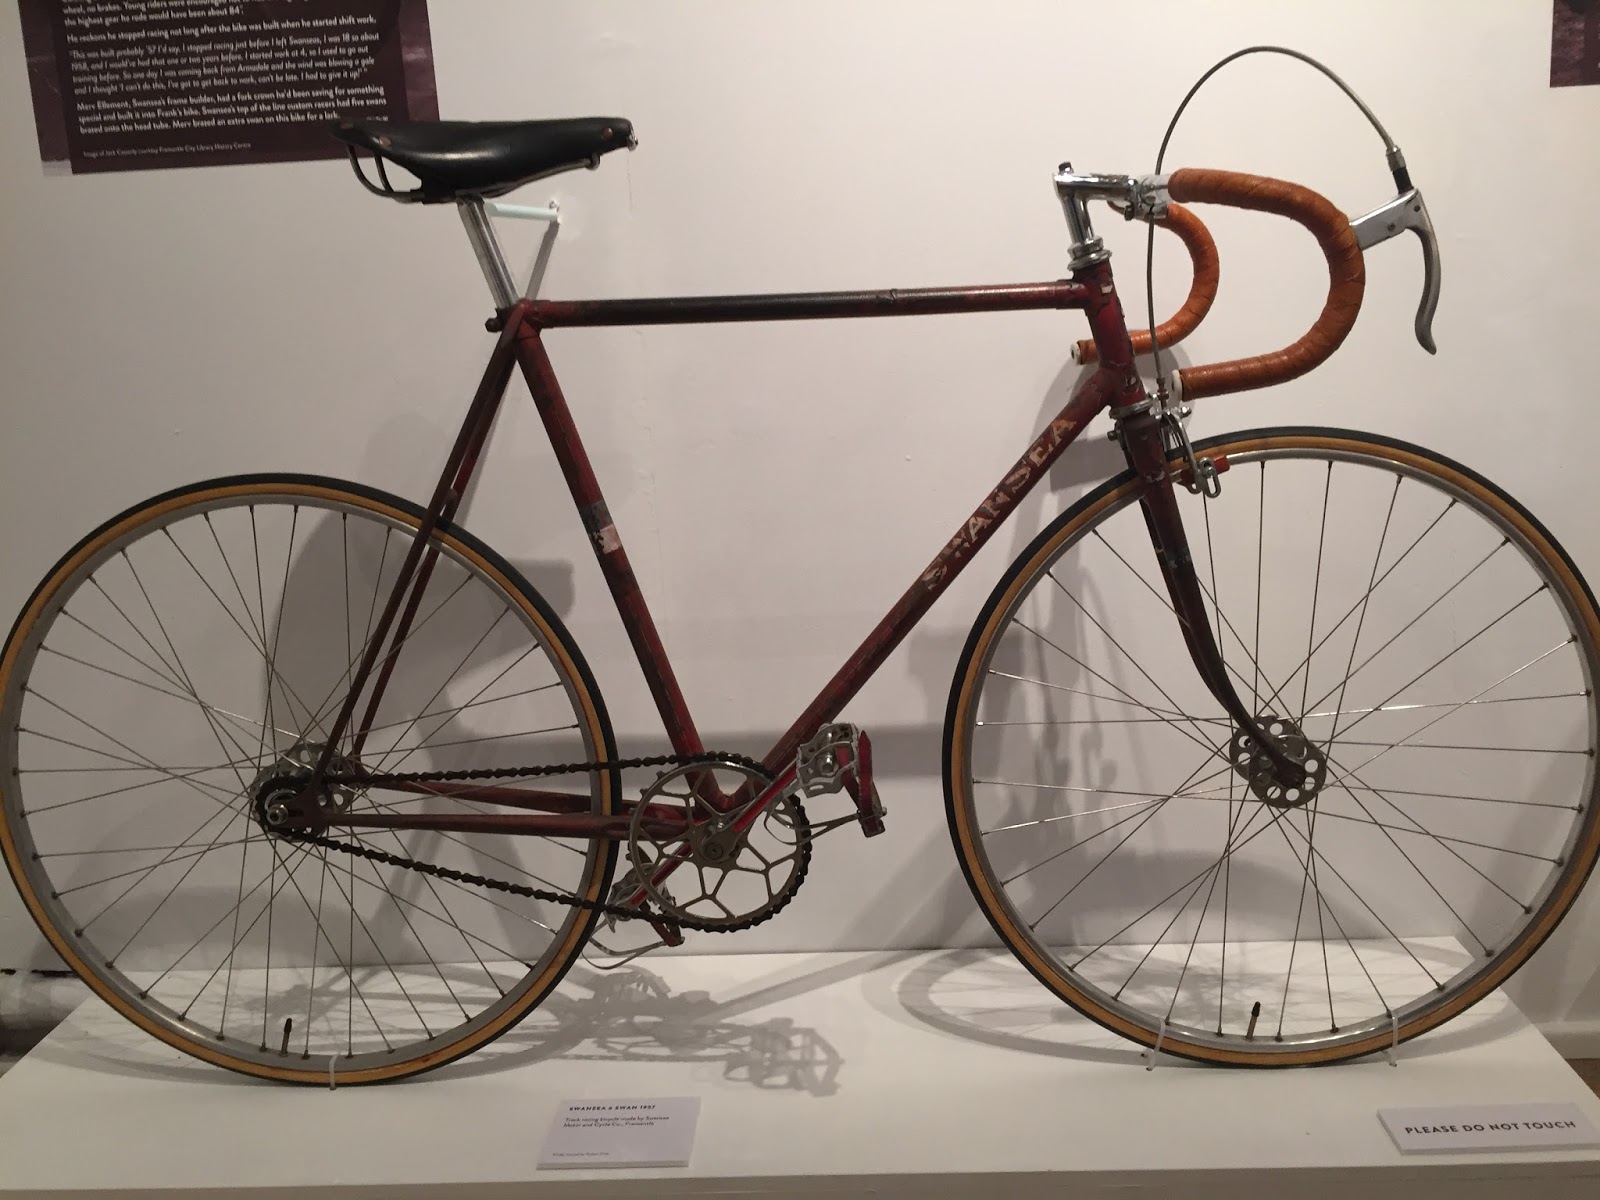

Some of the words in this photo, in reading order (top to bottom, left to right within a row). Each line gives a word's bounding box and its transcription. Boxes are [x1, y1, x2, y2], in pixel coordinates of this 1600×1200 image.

[67, 33, 77, 43] He
[80, 31, 106, 42] reckons
[107, 30, 116, 40] he
[118, 28, 145, 41] stopped
[147, 27, 168, 40] racing
[170, 26, 181, 36] not
[183, 25, 199, 37] long
[200, 24, 216, 34] after
[219, 23, 230, 33] the
[232, 22, 247, 32] bike
[249, 23, 261, 31] was
[263, 20, 279, 30] built
[281, 18, 300, 29] when
[301, 18, 310, 27] he
[312, 16, 337, 27] started
[339, 15, 355, 25] shift
[357, 13, 376, 24] work.
[77, 101, 95, 111] Merv
[132, 96, 165, 108] Swansea's
[167, 95, 188, 106] frame
[189, 93, 215, 105] builder,
[217, 92, 230, 102] had
[237, 91, 252, 101] fork
[254, 92, 275, 100] crown
[276, 89, 291, 99] he'd
[293, 88, 310, 98] been
[311, 86, 333, 99] saving
[335, 85, 345, 95] for
[347, 83, 384, 97] something
[79, 112, 101, 125] special
[103, 111, 116, 121] and
[117, 110, 133, 120] built
[142, 109, 155, 119] into
[157, 107, 182, 118] Frank's
[184, 106, 200, 116] bike.
[202, 104, 235, 115] Swansea's
[237, 103, 248, 115] top
[259, 102, 271, 111] the
[272, 101, 285, 111] line
[287, 99, 312, 110] custom
[314, 100, 335, 108] racers
[337, 97, 350, 107] had
[351, 96, 364, 106] five
[366, 97, 386, 105] swans
[80, 124, 103, 134] brazed
[104, 123, 120, 133] onto
[121, 122, 133, 132] the
[134, 121, 151, 131] head
[153, 120, 170, 130] tube.
[172, 119, 191, 129] Merv
[193, 117, 215, 128] brazed
[227, 115, 245, 126] extra
[276, 113, 289, 123] this
[290, 112, 305, 122] bike
[307, 111, 317, 121] for
[325, 110, 340, 120] lark.
[1404, 1125, 1459, 1134] PLEASE
[1461, 1124, 1485, 1132] DO
[1488, 1123, 1520, 1131] NOT
[1522, 1121, 1576, 1130] TOUCH
